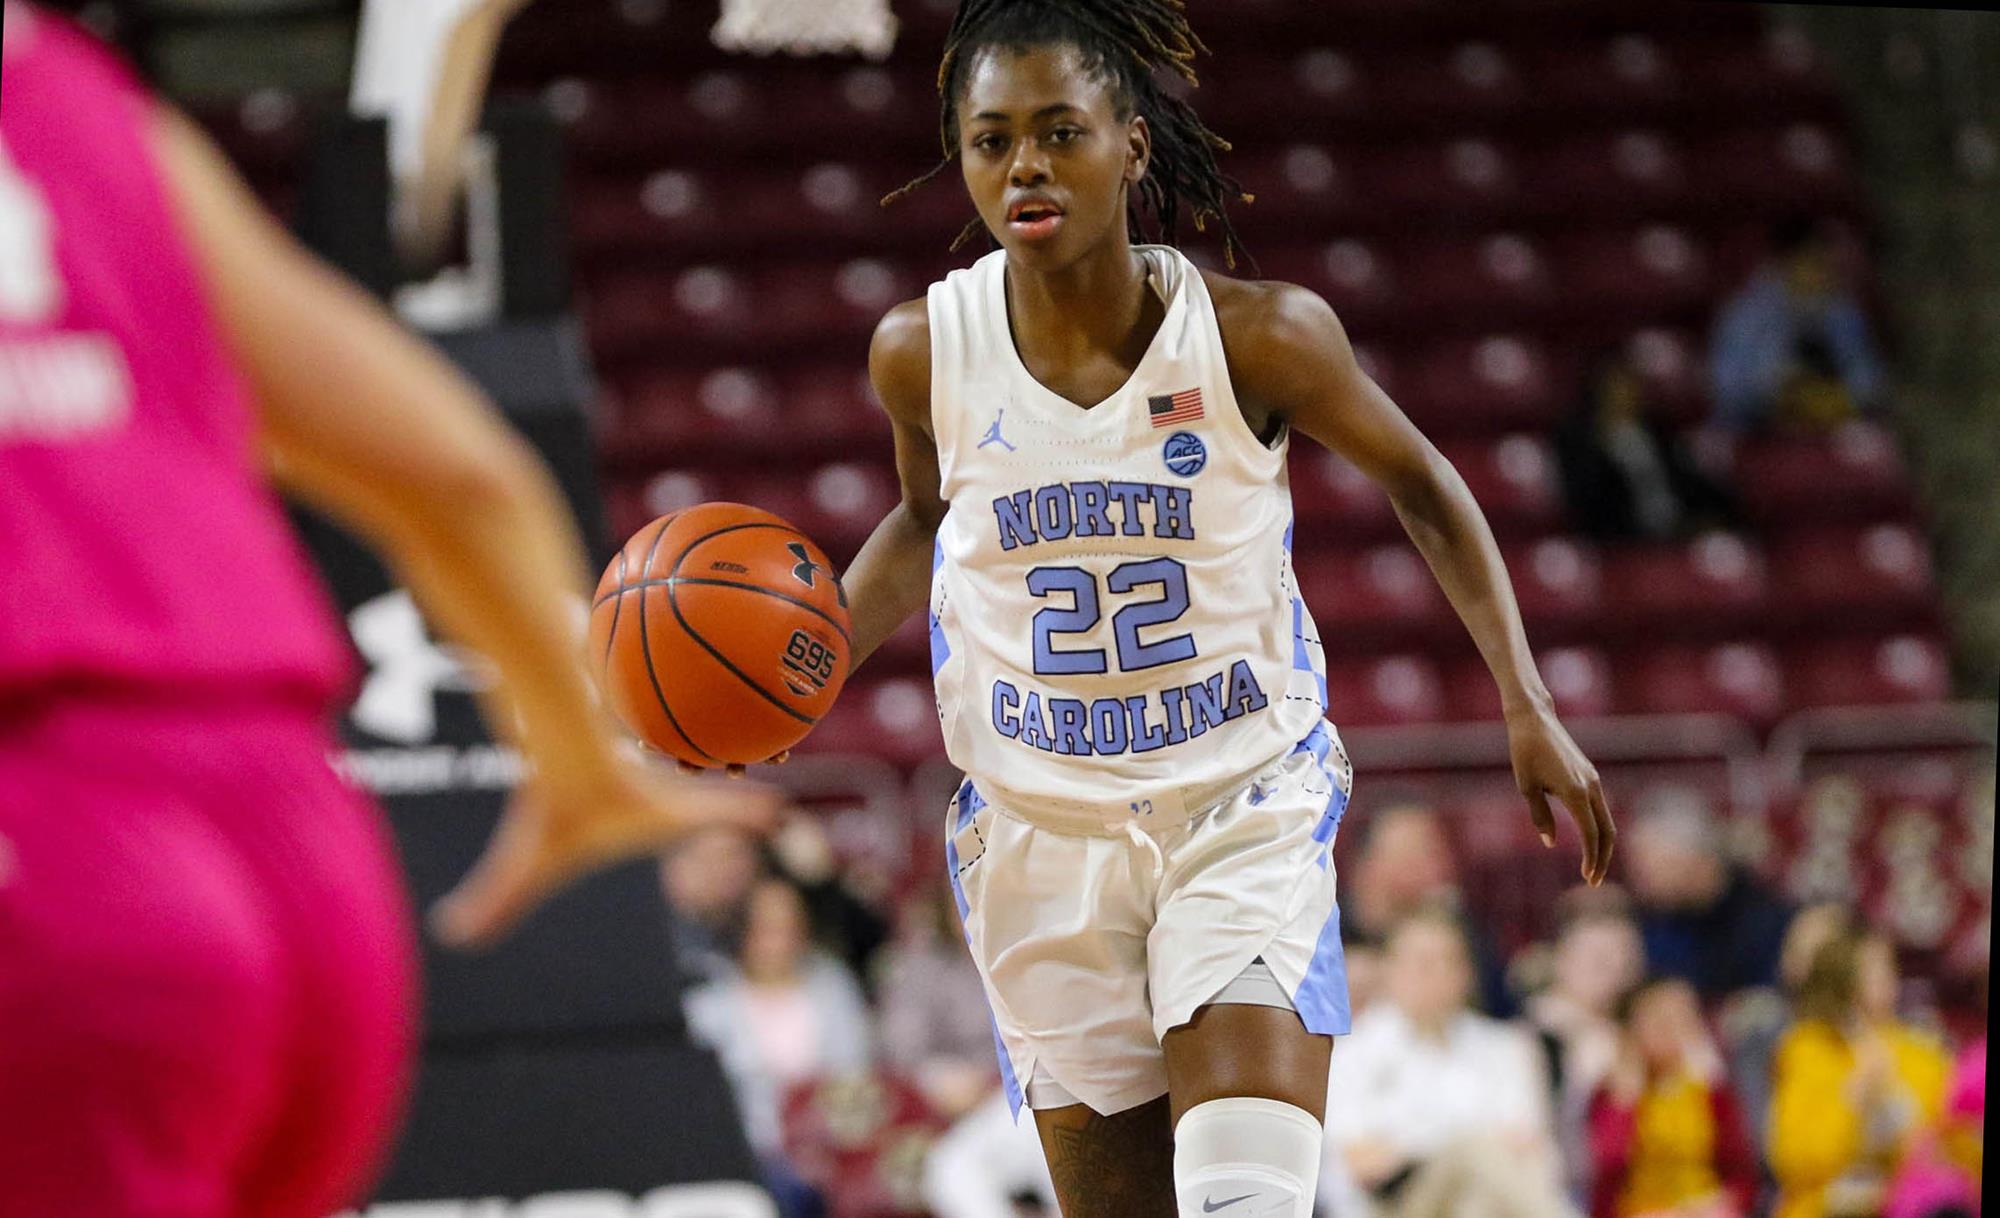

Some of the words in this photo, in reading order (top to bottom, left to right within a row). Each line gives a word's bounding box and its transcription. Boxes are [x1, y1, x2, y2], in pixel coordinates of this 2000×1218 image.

[1170, 443, 1202, 458] ACC
[993, 481, 1195, 551] NORTH
[1026, 556, 1197, 675] 22
[787, 630, 836, 679] 695
[992, 659, 1267, 756] CAROLINA
